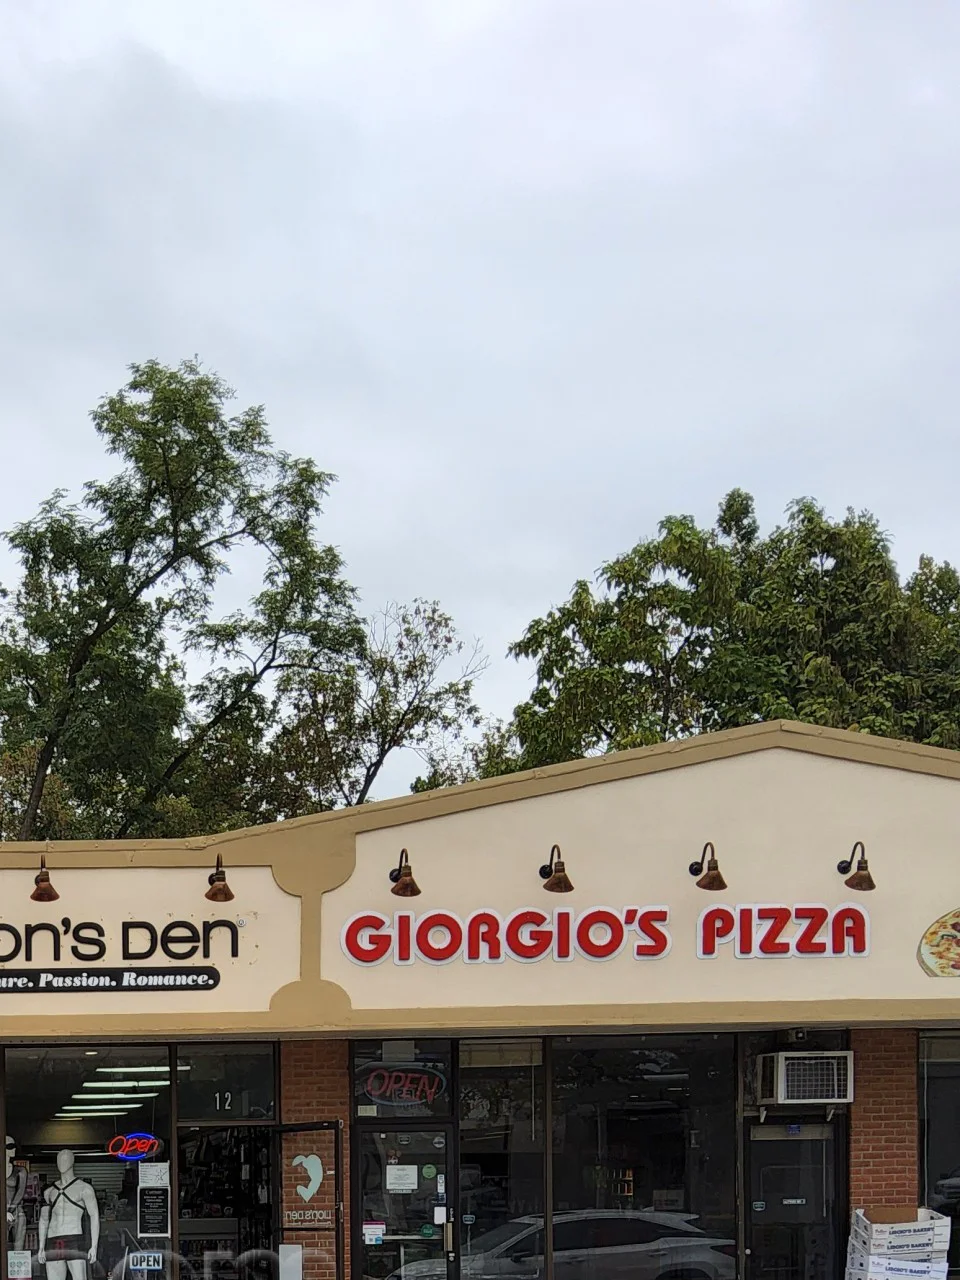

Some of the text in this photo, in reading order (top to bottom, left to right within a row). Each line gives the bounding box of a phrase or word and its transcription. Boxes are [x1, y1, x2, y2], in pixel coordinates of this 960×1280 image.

[343, 905, 868, 964] GIORGIO'S PIZZA
[39, 971, 118, 990] Passion.
[121, 970, 215, 988] Romance.
[367, 1068, 440, 1105] OPEN
[214, 1091, 232, 1111] 12
[109, 1135, 159, 1155] Open
[131, 1254, 161, 1267] OPEN
